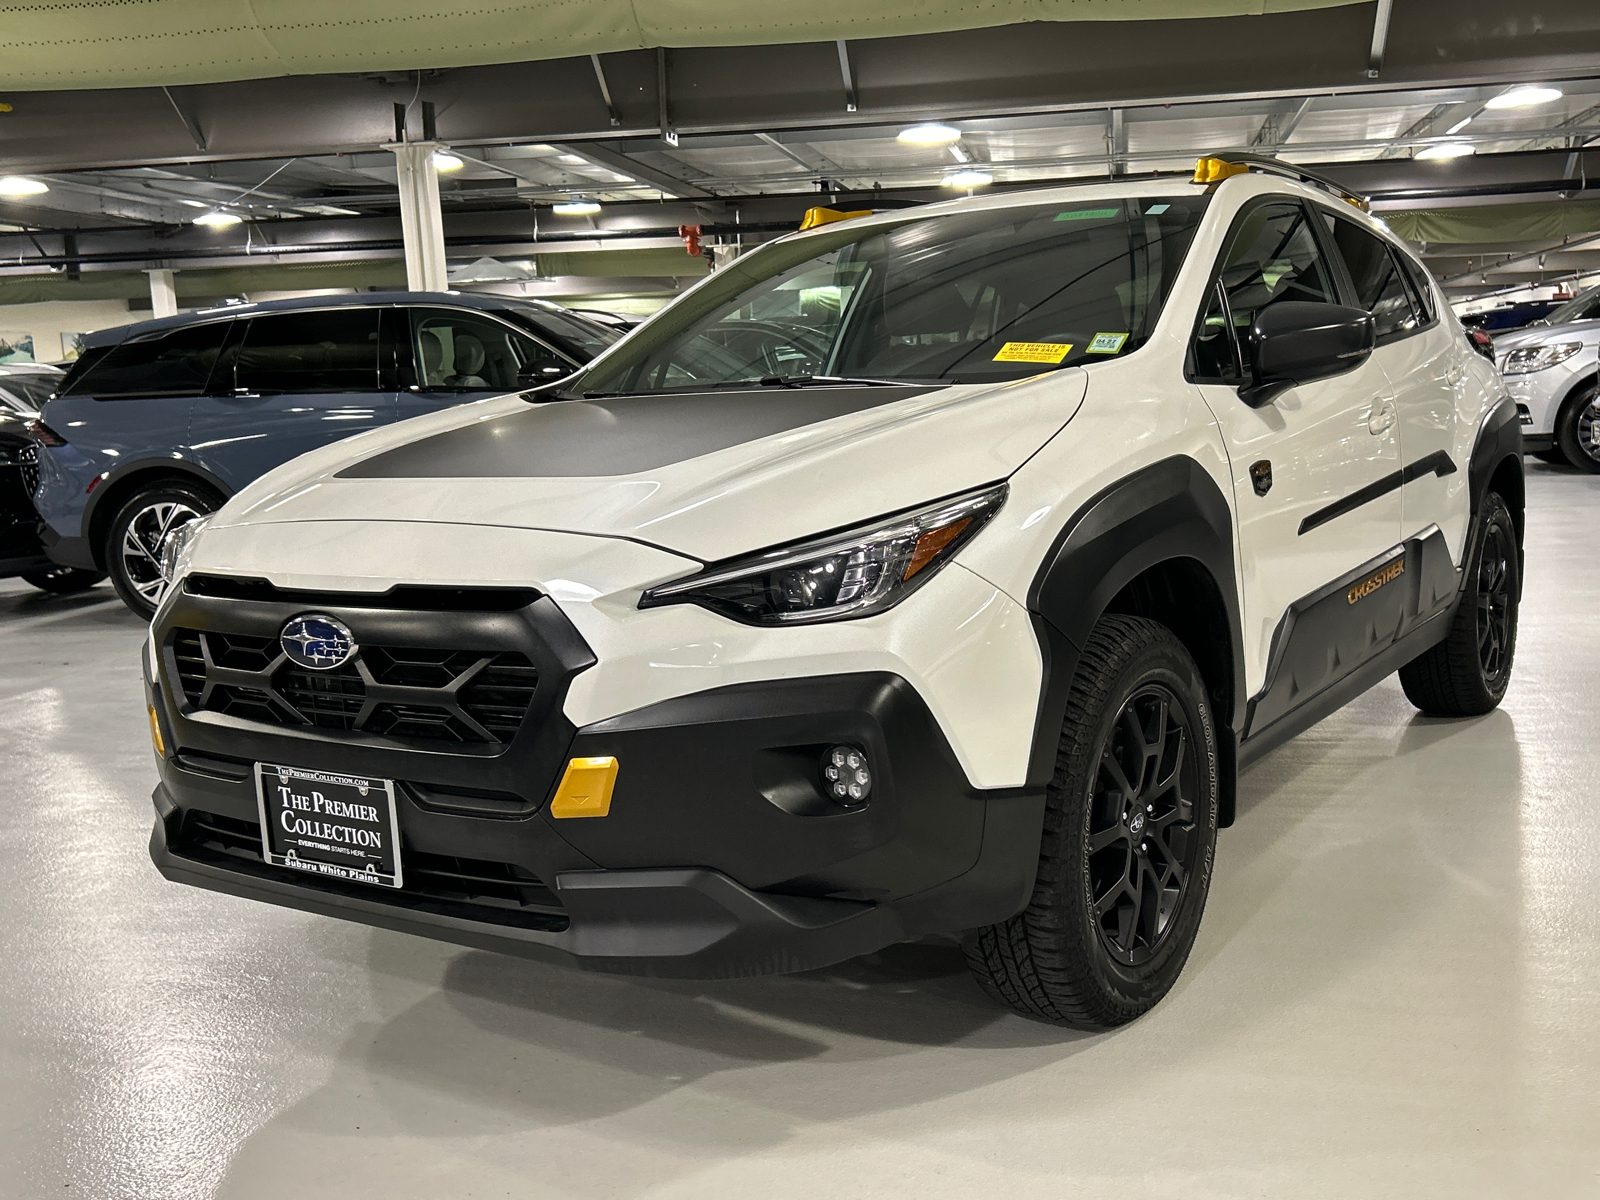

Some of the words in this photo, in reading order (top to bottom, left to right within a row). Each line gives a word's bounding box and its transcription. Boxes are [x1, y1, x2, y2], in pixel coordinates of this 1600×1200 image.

[1347, 559, 1405, 604] CROSSTREK
[1198, 703, 1218, 829] GEOLANDAR
[297, 839, 331, 851] EVERYTHING
[331, 845, 350, 855] STARTS
[284, 858, 317, 871] Subaru
[319, 864, 347, 877] White
[349, 869, 380, 883] Plains
